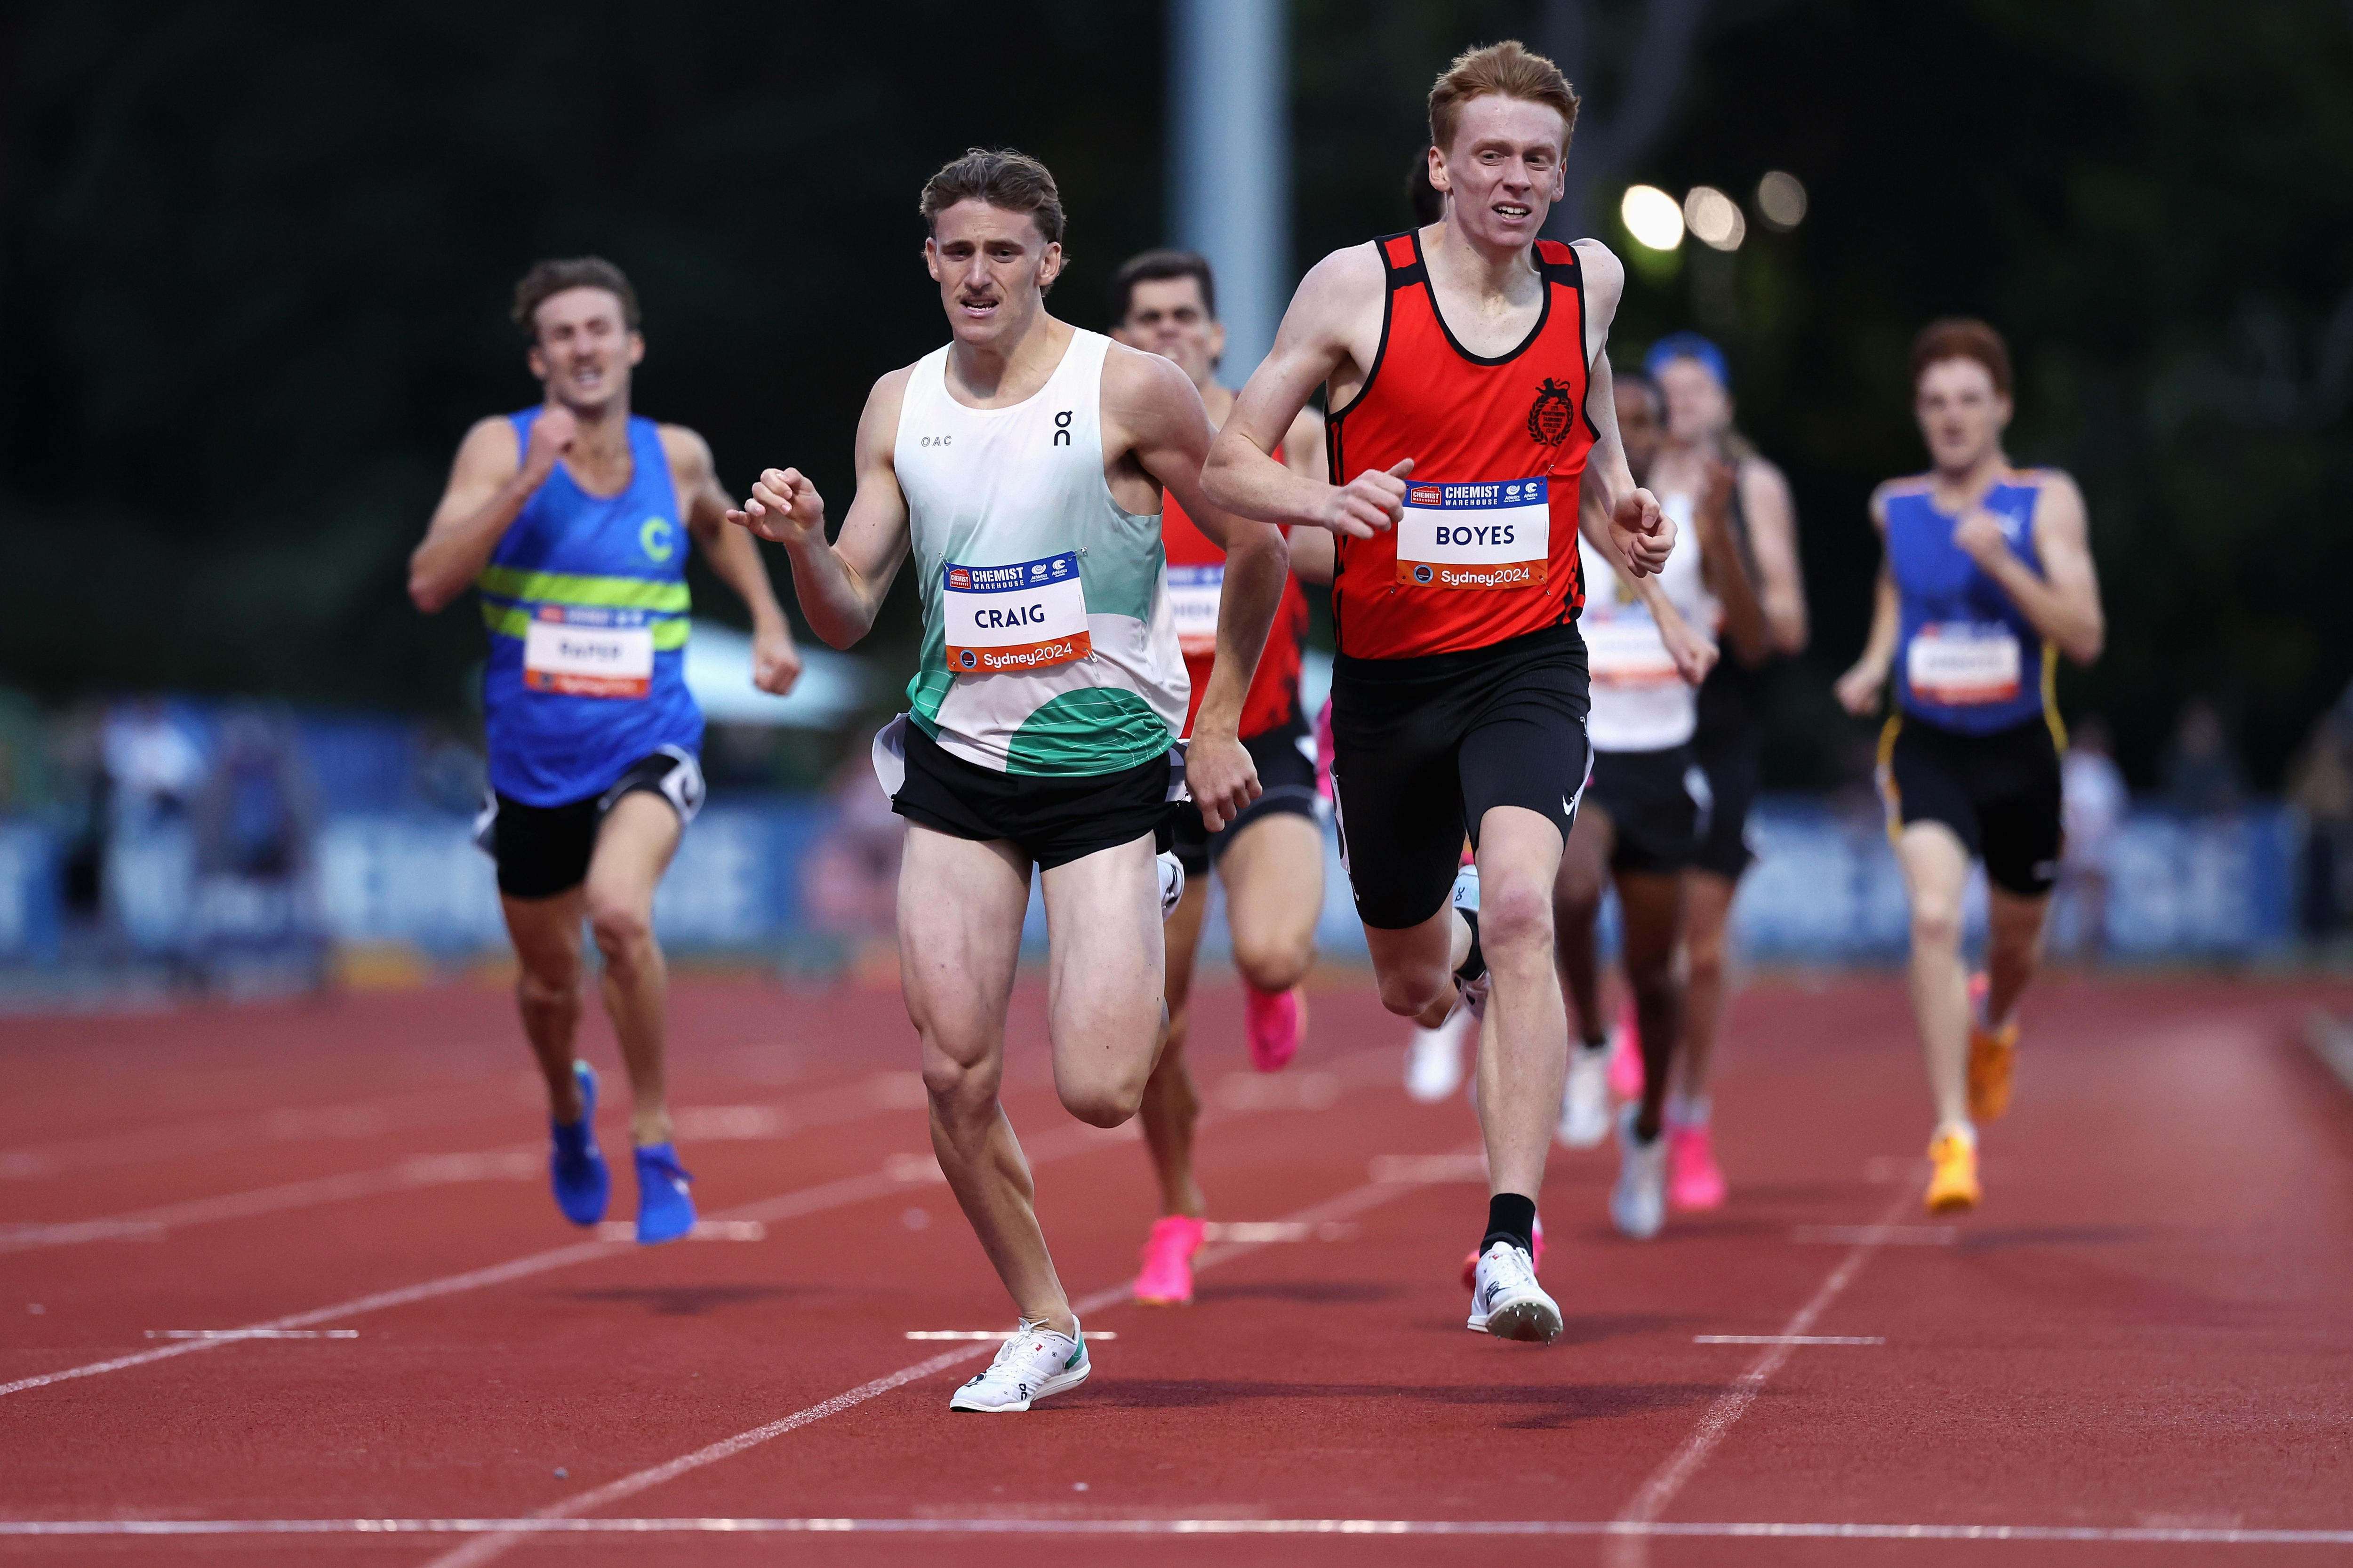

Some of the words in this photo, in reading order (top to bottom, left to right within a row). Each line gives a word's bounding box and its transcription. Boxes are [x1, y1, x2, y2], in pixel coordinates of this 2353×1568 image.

[921, 435, 952, 447] OAC
[1413, 491, 1440, 499] CHEMIST
[1445, 486, 1500, 499] CHEMIST
[1436, 525, 1515, 545] BOYES
[951, 574, 968, 583] CHEMIST
[972, 567, 1024, 583] CHEMIST
[1441, 568, 1530, 587] Sydney2024
[974, 580, 1024, 590] WAREHOUSE
[975, 604, 1045, 629] CRAIG
[984, 642, 1073, 668] Sydney2024
